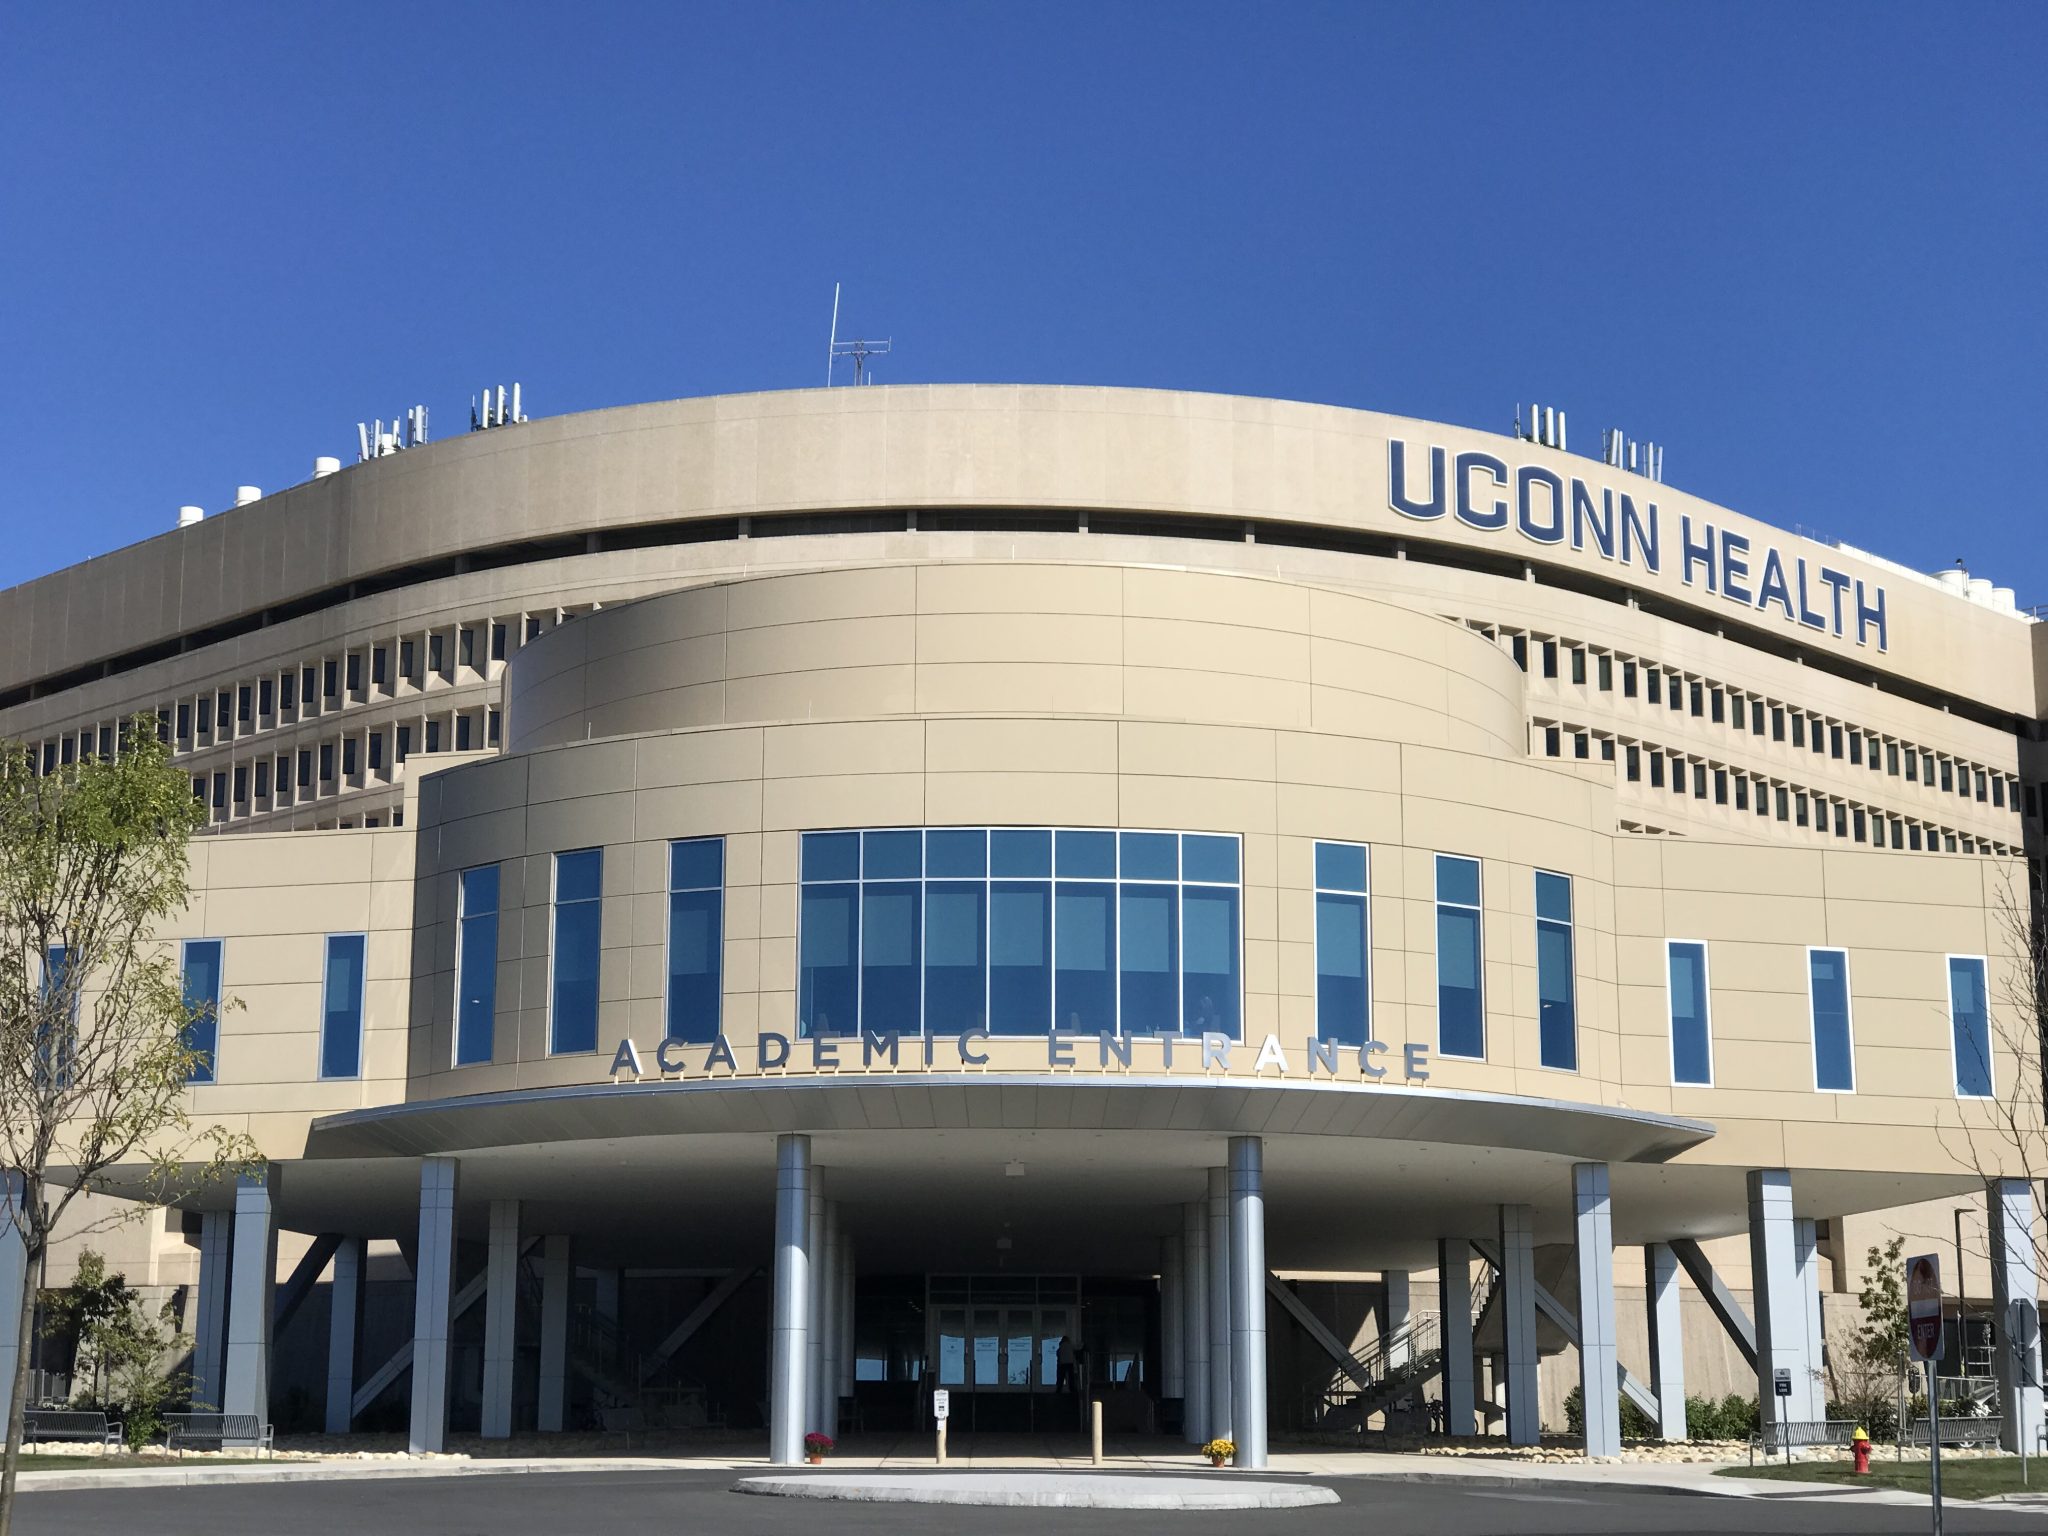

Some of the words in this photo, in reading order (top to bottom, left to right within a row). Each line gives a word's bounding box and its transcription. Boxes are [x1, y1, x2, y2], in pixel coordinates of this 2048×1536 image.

[1388, 437, 1661, 575] UCONN
[1681, 513, 1889, 653] HEALTH
[609, 1027, 991, 1076] ACADEMIC
[1048, 1029, 1430, 1079] ENTRANCE
